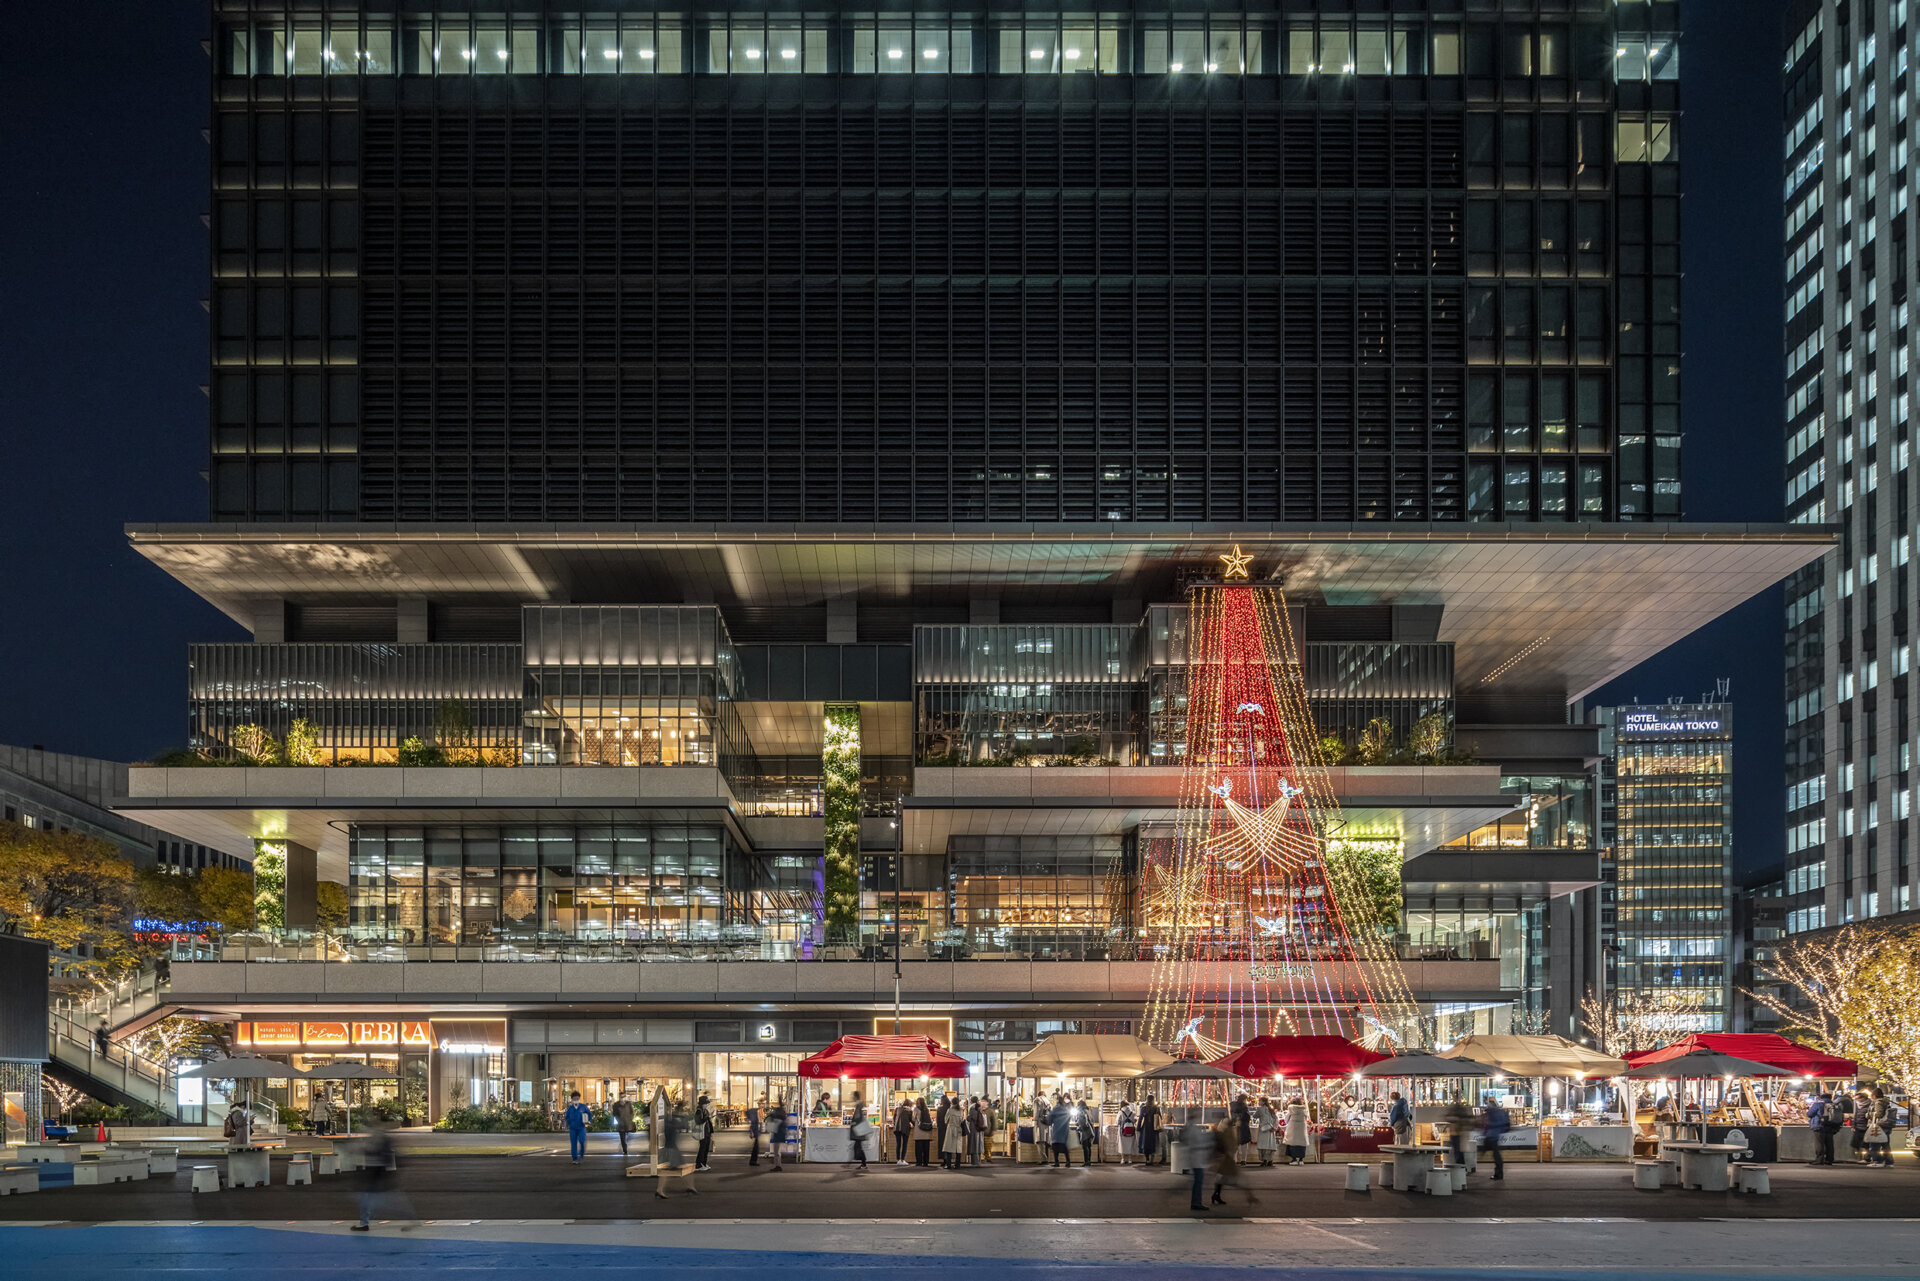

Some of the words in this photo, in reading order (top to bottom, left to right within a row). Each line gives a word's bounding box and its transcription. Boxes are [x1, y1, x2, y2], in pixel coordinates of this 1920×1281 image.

[1626, 714, 1658, 723] HOTEL
[1626, 723, 1684, 732] RYUMEIKAN
[1686, 721, 1719, 730] TOKYO
